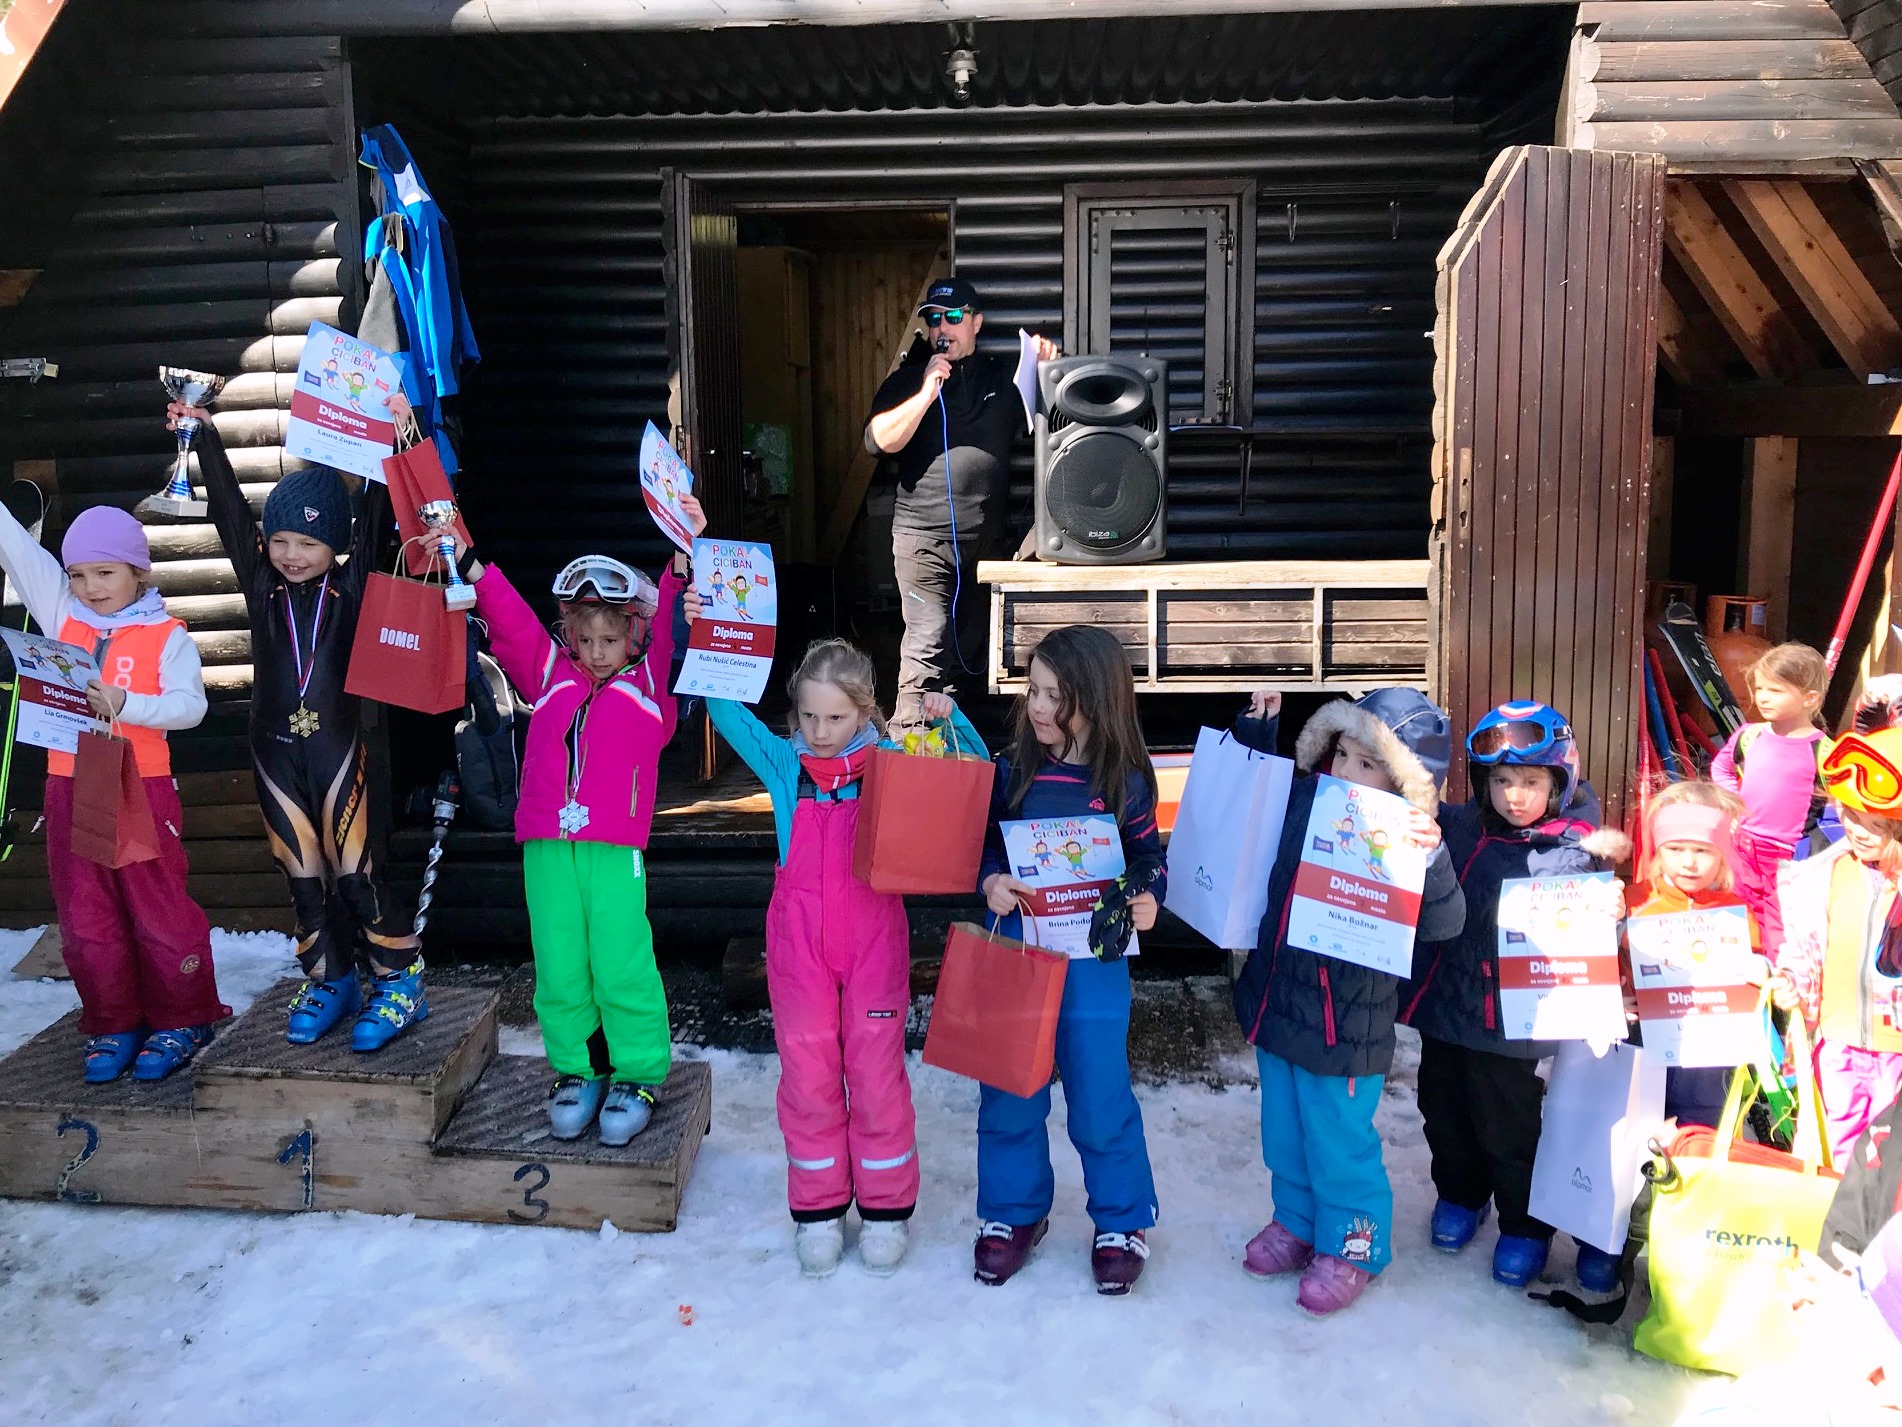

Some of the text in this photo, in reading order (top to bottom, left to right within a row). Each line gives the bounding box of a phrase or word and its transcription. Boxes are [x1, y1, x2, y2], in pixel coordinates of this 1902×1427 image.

[331, 347, 377, 373] CICIBAN
[318, 404, 368, 430] Diploma
[317, 428, 338, 441] Laura
[339, 436, 362, 448] Zupan
[713, 558, 752, 569] CICIBAN
[712, 625, 754, 641] Diploma
[698, 653, 712, 663] Rubi
[729, 657, 757, 669] Celestina
[42, 685, 88, 706] Diploma
[44, 708, 55, 718] Lia
[1033, 828, 1088, 839] CICIBAN
[1045, 887, 1101, 904] Diploma
[1329, 875, 1389, 904] Diploma
[1530, 891, 1583, 902] CIIBAN
[1070, 917, 1093, 927] Podo
[1328, 910, 1379, 931] Nika Božnar
[56, 1118, 101, 1202] 2
[276, 1127, 314, 1209] 1
[506, 1163, 551, 1224] 3
[1705, 1228, 1799, 1259] rexroth
